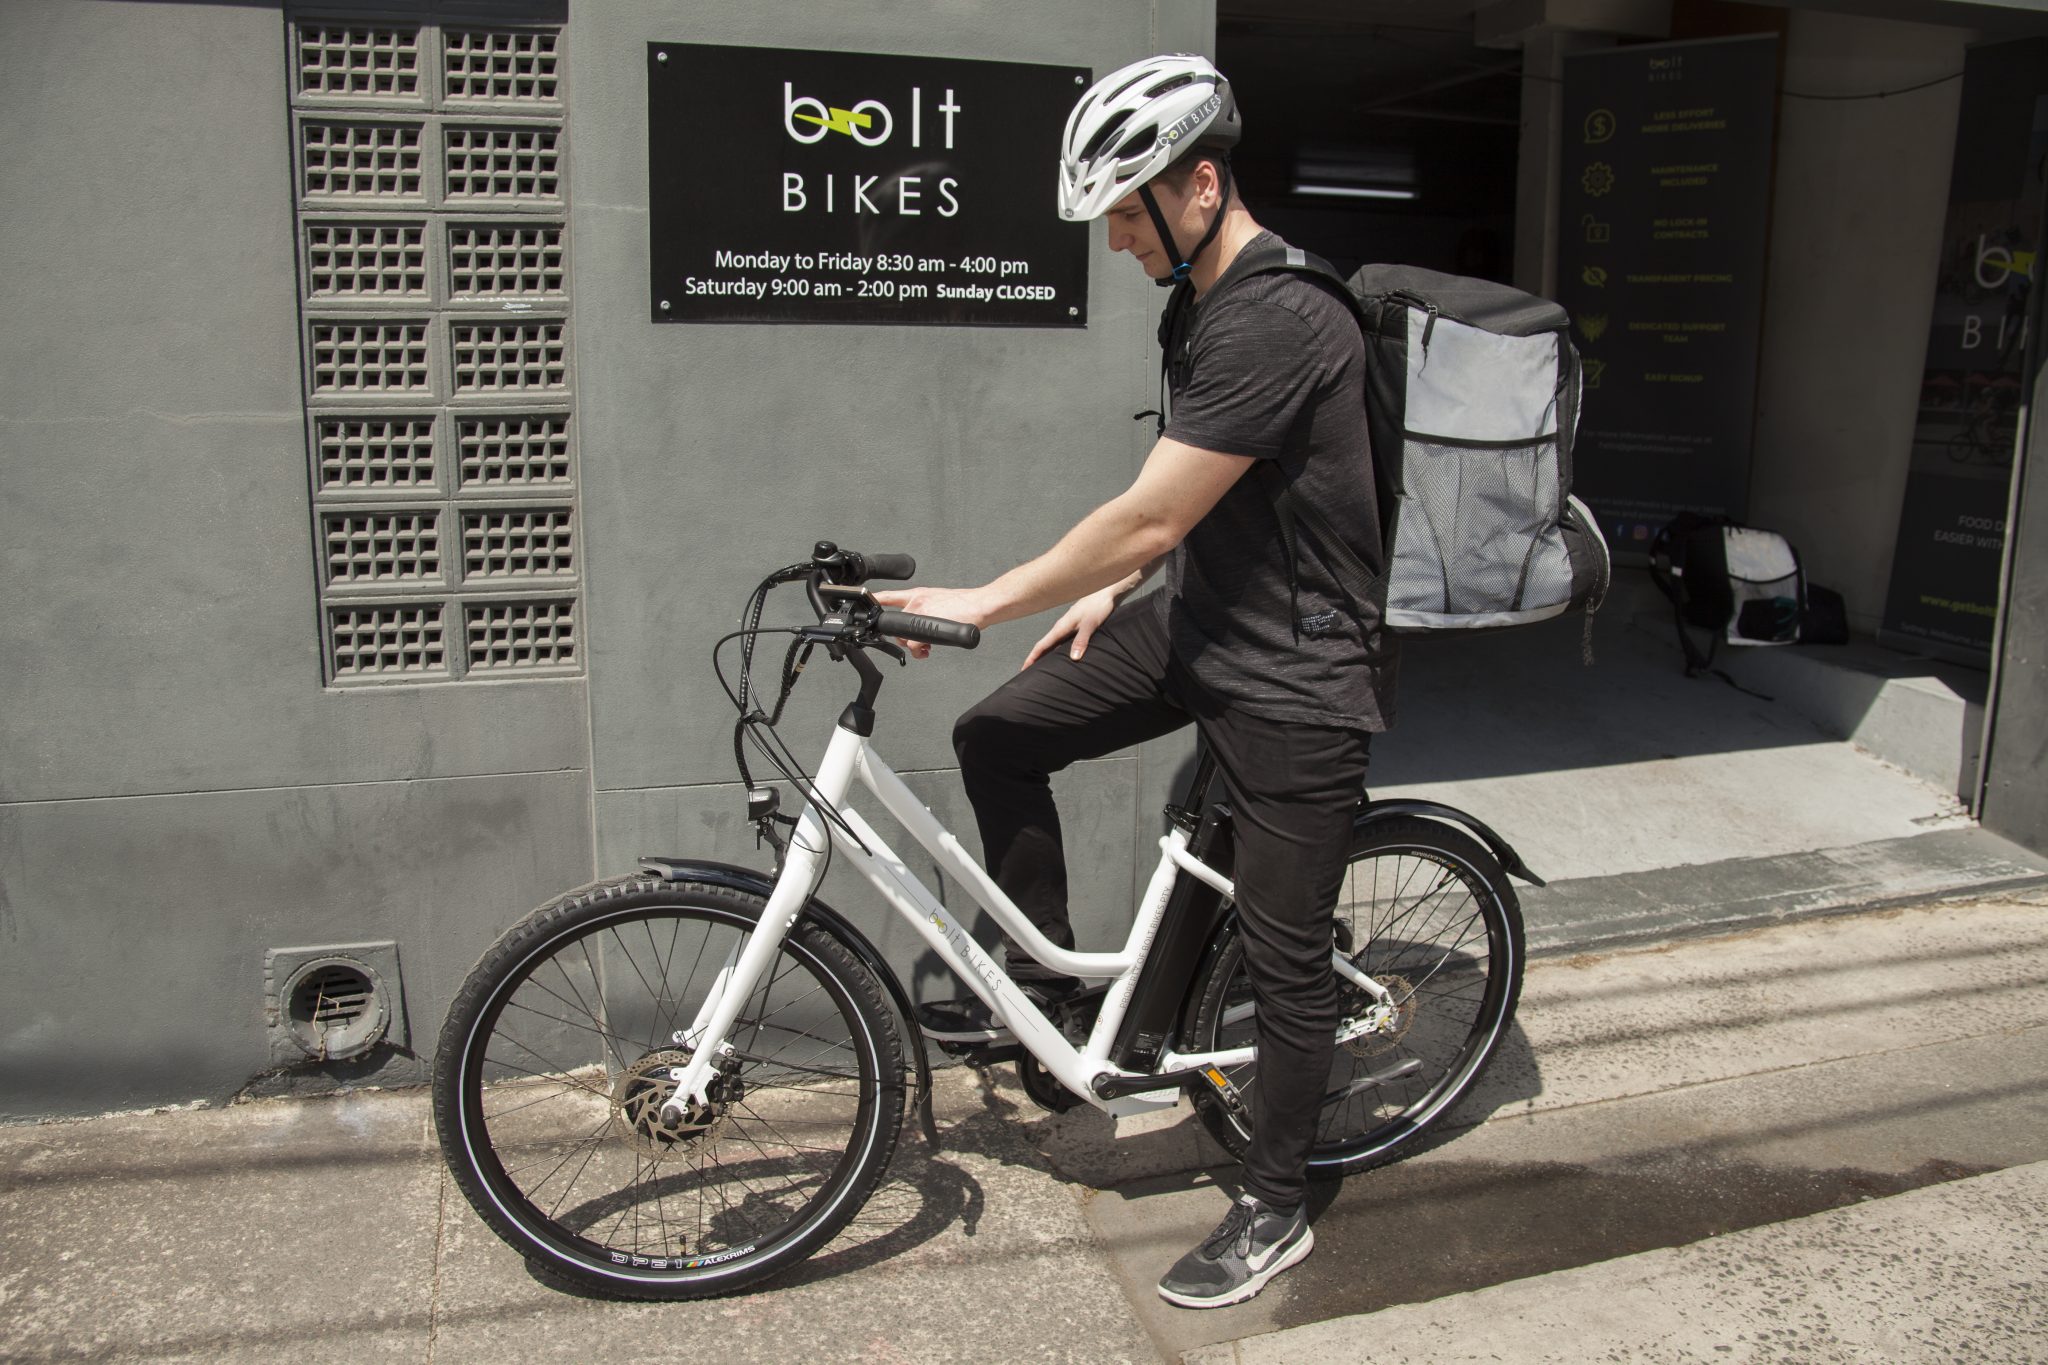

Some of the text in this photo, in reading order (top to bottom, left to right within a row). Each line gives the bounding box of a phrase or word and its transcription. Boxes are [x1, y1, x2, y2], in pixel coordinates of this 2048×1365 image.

[784, 81, 961, 149] bolt
[1157, 94, 1222, 146] bolt BIKES
[1678, 108, 1714, 119] EFFORT
[1671, 120, 1726, 132] DELIVERIES
[1651, 163, 1718, 174] MAINTENANCE
[783, 173, 959, 217] BIKES
[1653, 230, 1709, 240] CONTRACTS
[716, 250, 790, 273] Monday
[794, 253, 814, 270] to
[819, 252, 873, 275] Friday
[877, 254, 914, 271] 8:30
[918, 258, 945, 272] am
[960, 256, 997, 273] 4:00
[1001, 260, 1029, 277] pm
[1626, 274, 1733, 283] TRANSPARENT PRICING
[686, 276, 767, 300] Saturday
[771, 278, 810, 296] 9:00
[813, 282, 842, 296] am
[857, 280, 895, 297] 2:00
[899, 284, 928, 301] pm
[936, 284, 994, 302] Sunday
[996, 285, 1056, 300] CLOSED
[1628, 321, 1726, 332] DEDICATED SUPPORT
[1663, 334, 1688, 343] TEAM
[1958, 514, 1993, 530] FOOD
[1934, 530, 1974, 546] EASIER
[928, 907, 1002, 992] bolt BIKES
[1119, 886, 1172, 1009] PROPERTY OF BOLT BIKES PTY
[703, 1245, 756, 1266] ALEXRIMS
